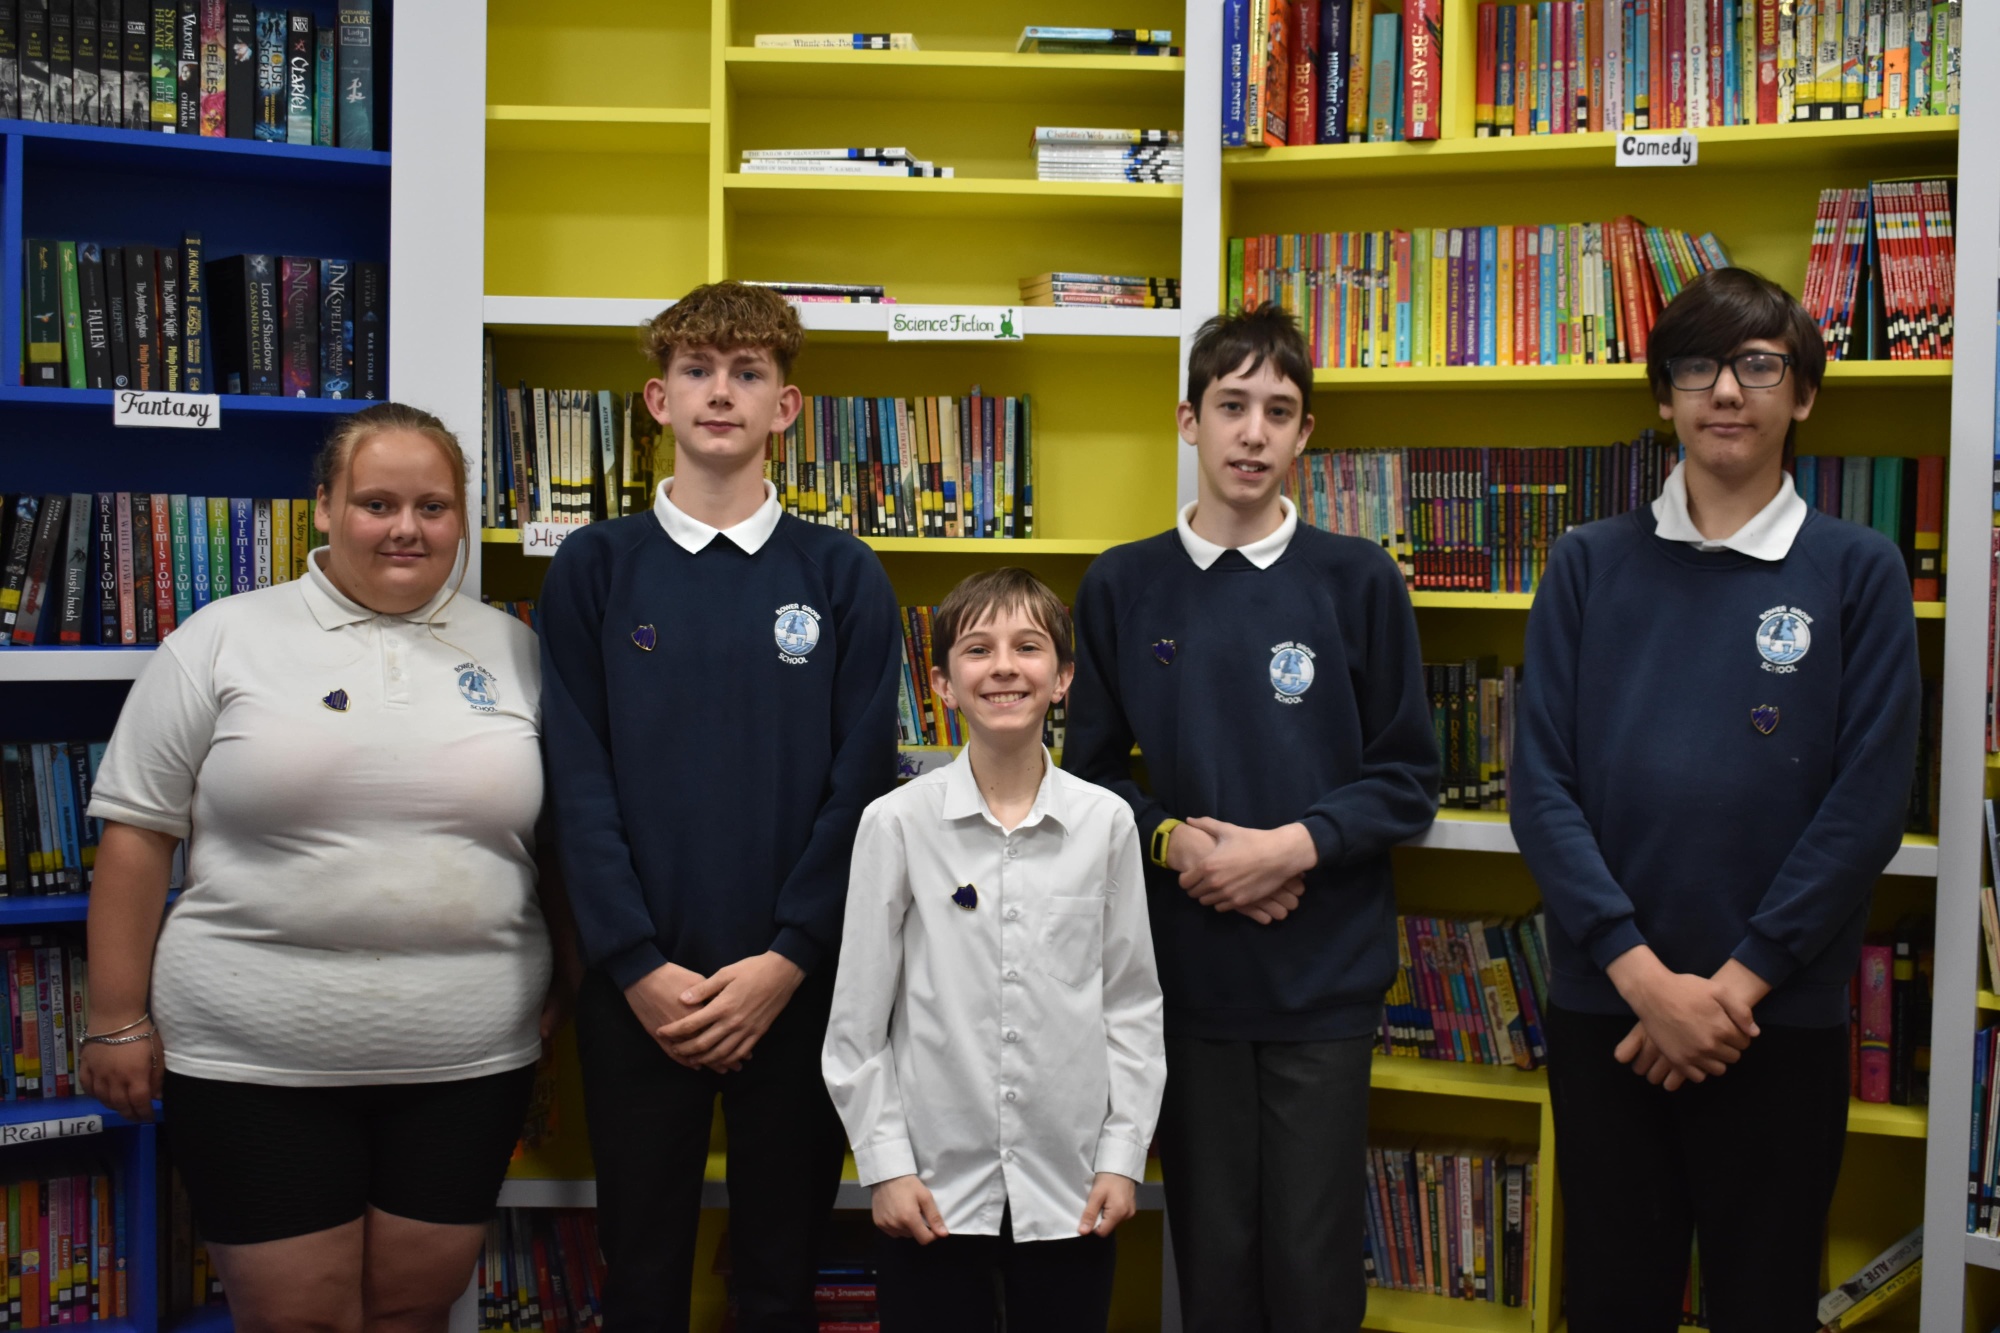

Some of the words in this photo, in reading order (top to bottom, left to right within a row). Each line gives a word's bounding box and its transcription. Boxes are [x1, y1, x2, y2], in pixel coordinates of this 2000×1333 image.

[127, 24, 146, 32] CLARE
[156, 9, 164, 47] HEART
[165, 9, 176, 51] STONE
[340, 15, 370, 24] CLARE
[1936, 14, 1945, 40] WHAT
[182, 14, 197, 60] VALKYRIE
[207, 44, 218, 94] BELLES
[1231, 44, 1240, 78] DEMON
[1411, 35, 1428, 90] BEAST
[1295, 62, 1310, 114] BEAST
[1326, 52, 1339, 103] MIDNIGHT
[1231, 82, 1240, 121] DENTIST
[1325, 106, 1337, 136] GANG
[1623, 136, 1691, 164] Comedy
[189, 260, 199, 292] ROWLING
[250, 282, 258, 338] CASSANDRA
[261, 282, 271, 307] Lord
[88, 308, 105, 350] FALLEN
[262, 308, 271, 320] of
[894, 314, 948, 332] Science
[950, 314, 994, 332] Fiction
[138, 344, 149, 362] Philip
[166, 346, 177, 364] Philip
[252, 339, 261, 370] CLARE
[262, 322, 272, 371] Shadows
[140, 364, 150, 390] Pullman
[168, 366, 178, 390] Pullman
[121, 393, 212, 426] Fantasy
[536, 398, 544, 434] HIDDEN
[512, 432, 522, 462] MICHAEL
[514, 464, 525, 504] MORPURGO
[100, 496, 112, 560] ARTEMIS
[155, 498, 168, 560] ARTEMIS
[175, 500, 187, 561] ARTEMIS
[194, 500, 206, 562] ARTEMIS
[214, 500, 226, 562] ARTEMIS
[257, 500, 268, 562] ARTEMIS
[276, 500, 287, 562] ARTEMIS
[298, 510, 306, 522] The
[120, 520, 129, 553] WHITE
[236, 502, 248, 564] ARTEMIS
[294, 522, 304, 543] Story
[101, 563, 114, 600] FOWL
[122, 558, 131, 594] TOWER
[157, 563, 170, 598] FOWL
[176, 565, 190, 600] FOWL
[195, 565, 208, 600] FOWL
[236, 567, 250, 594] FOW
[776, 603, 799, 616] BOWER
[802, 604, 822, 621] GROVE
[1758, 605, 1787, 620] BOWER
[1790, 607, 1814, 624] GROVE
[778, 652, 808, 664] SCHOOL
[1271, 641, 1294, 654] BOWER
[1296, 643, 1316, 658] GROVE
[454, 662, 475, 673] BOWER
[478, 666, 497, 682] GROVE
[1760, 662, 1798, 674] SCHOOL
[470, 704, 498, 712] SCHOOL
[1274, 692, 1303, 704] SCHOOL
[77, 758, 85, 768] The
[78, 770, 87, 805] Phantom
[20, 963, 34, 985] ALICE
[3, 1122, 46, 1143] Real
[1864, 1261, 1889, 1284] ALFIE
[814, 1289, 836, 1299] miley
[838, 1288, 876, 1296] Snowman
